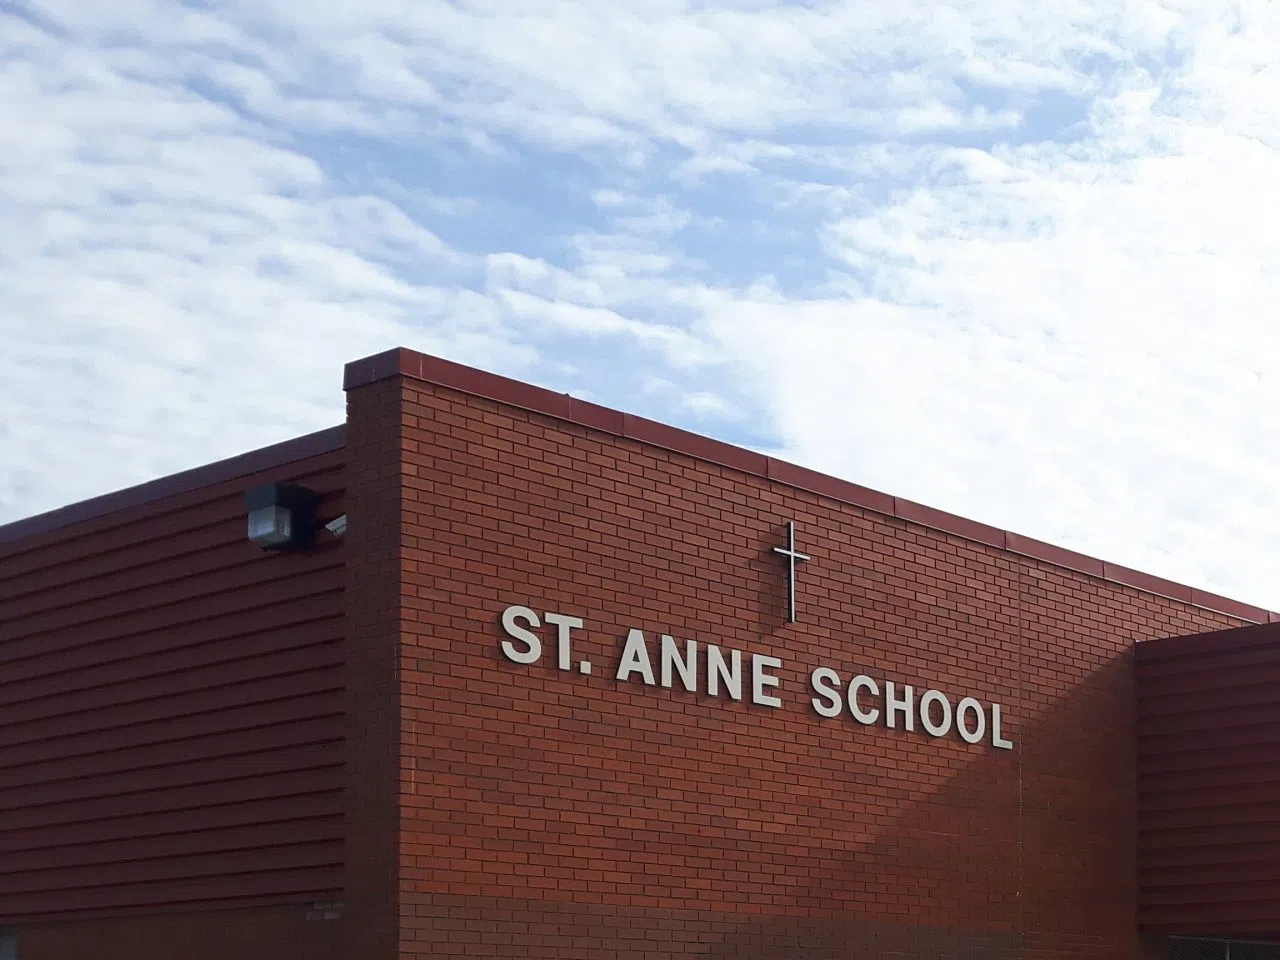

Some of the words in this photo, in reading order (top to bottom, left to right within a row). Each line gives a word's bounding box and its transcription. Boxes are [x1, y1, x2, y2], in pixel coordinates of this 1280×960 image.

[501, 605, 591, 675] ST.
[616, 628, 782, 708] ANNE
[811, 666, 1013, 749] SCHOOL
